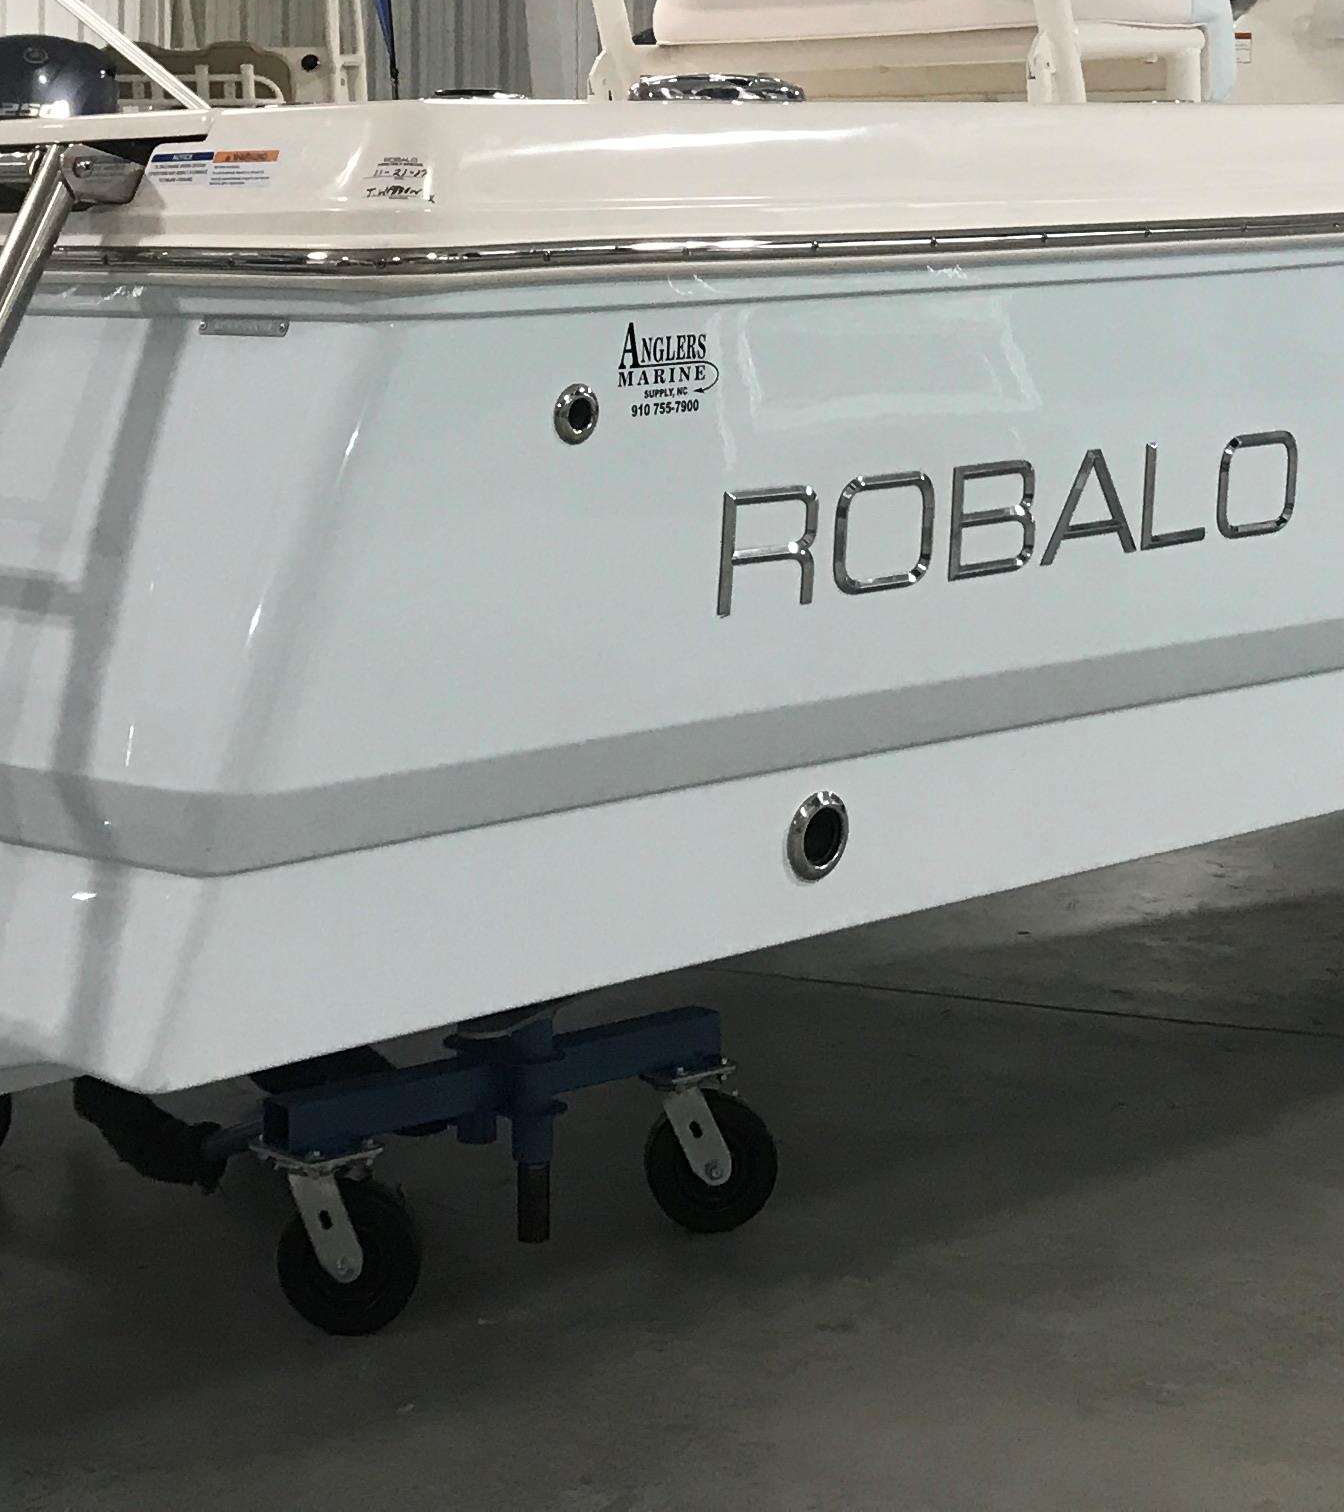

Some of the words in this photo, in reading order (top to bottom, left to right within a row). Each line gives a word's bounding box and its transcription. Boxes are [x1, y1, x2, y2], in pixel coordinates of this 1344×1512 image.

[618, 322, 707, 369] ANGLERS
[618, 365, 706, 388] MARINE
[644, 387, 675, 399] SUPPLY,
[676, 386, 688, 396] NC
[631, 403, 651, 418] 910
[653, 398, 700, 416] 755-7900
[716, 429, 1298, 618] ROBALO
